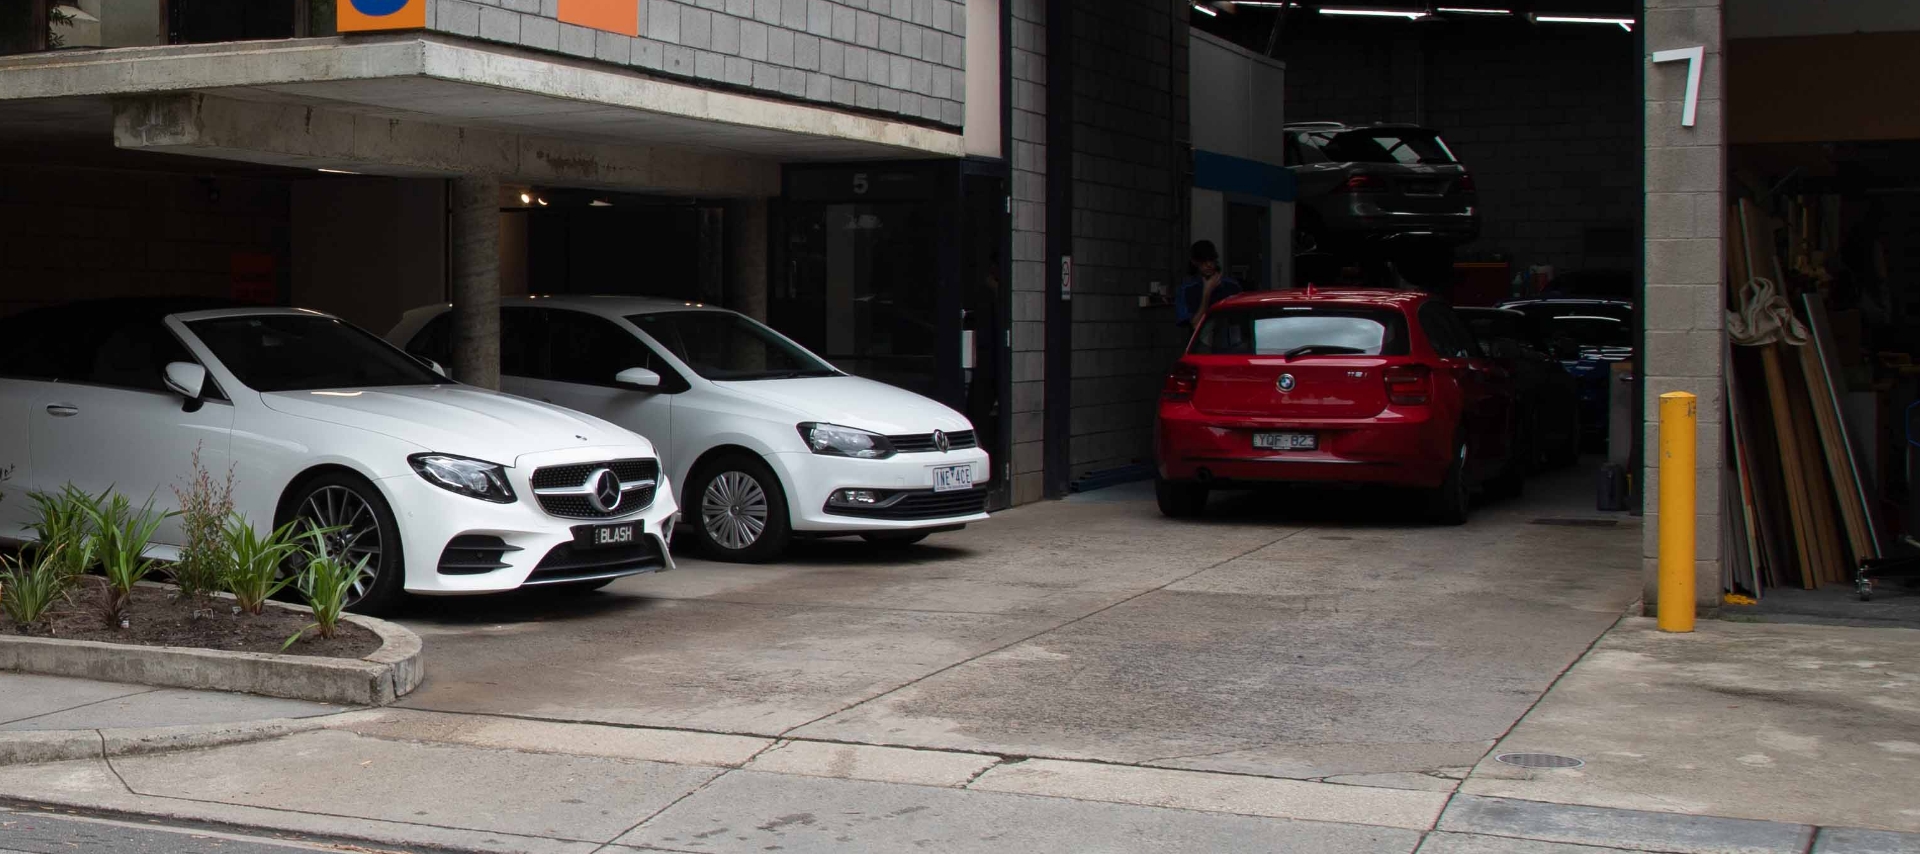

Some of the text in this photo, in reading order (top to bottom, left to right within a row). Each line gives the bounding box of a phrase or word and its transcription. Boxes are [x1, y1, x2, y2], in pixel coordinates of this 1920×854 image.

[1652, 46, 1704, 126] 7
[853, 173, 868, 193] 5
[600, 526, 632, 543] BLASH
